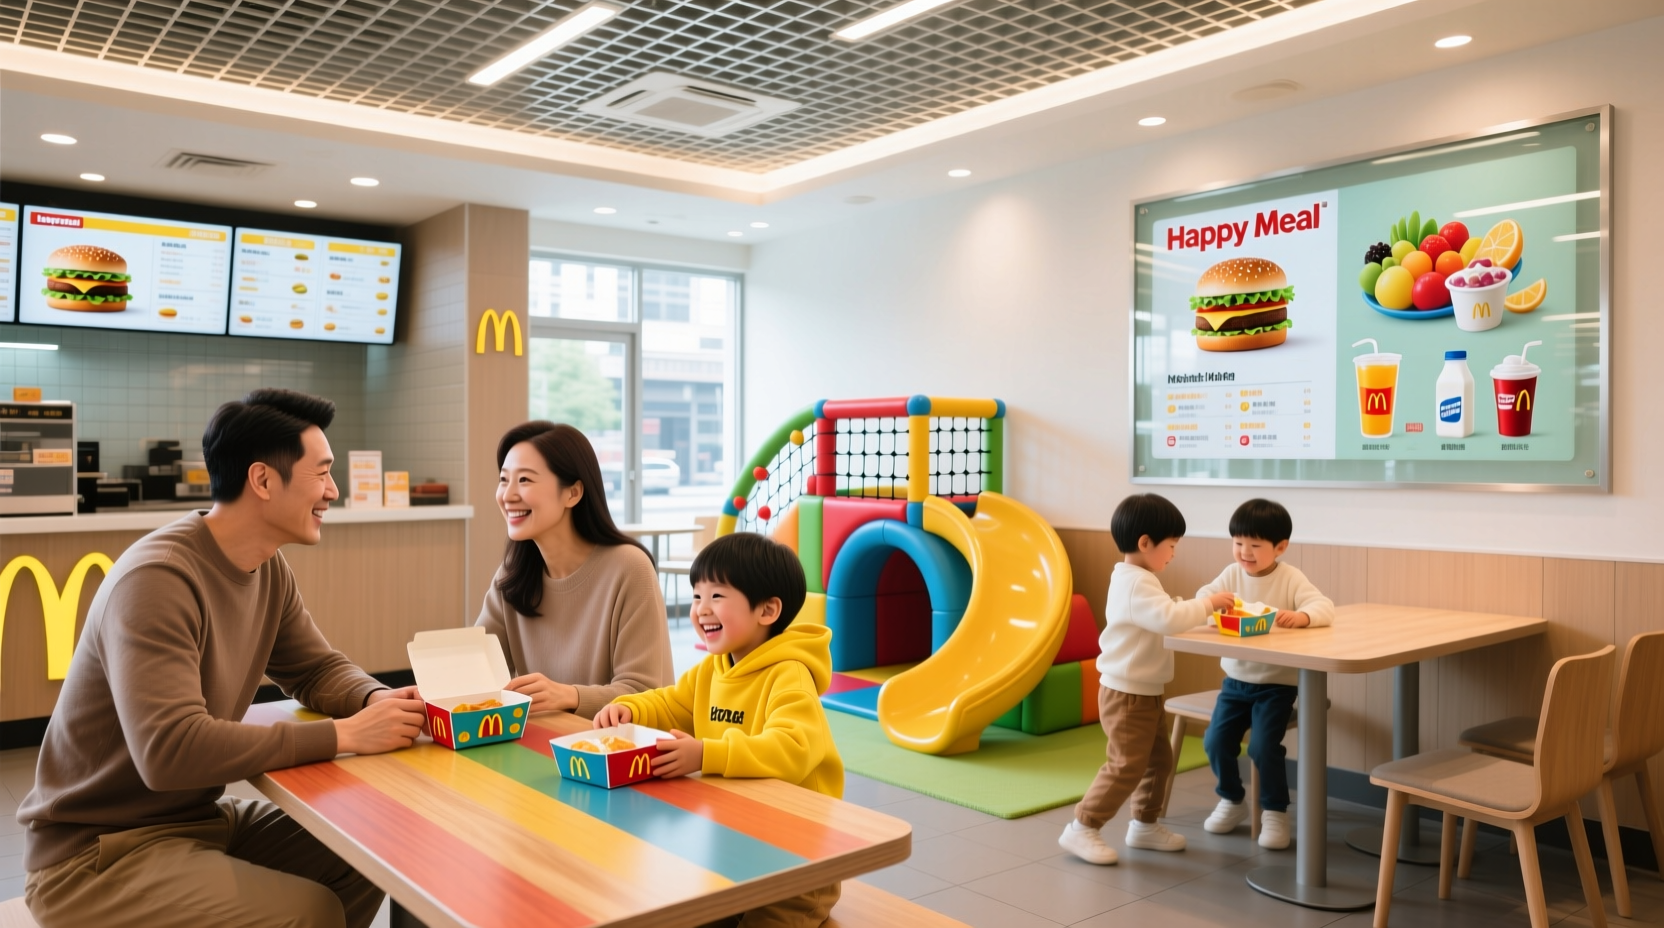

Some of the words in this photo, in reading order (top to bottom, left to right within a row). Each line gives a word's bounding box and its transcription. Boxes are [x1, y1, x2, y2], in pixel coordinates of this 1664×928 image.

[1167, 220, 1249, 252] Happy
[1254, 203, 1320, 238] Meal
[476, 308, 523, 357] M
